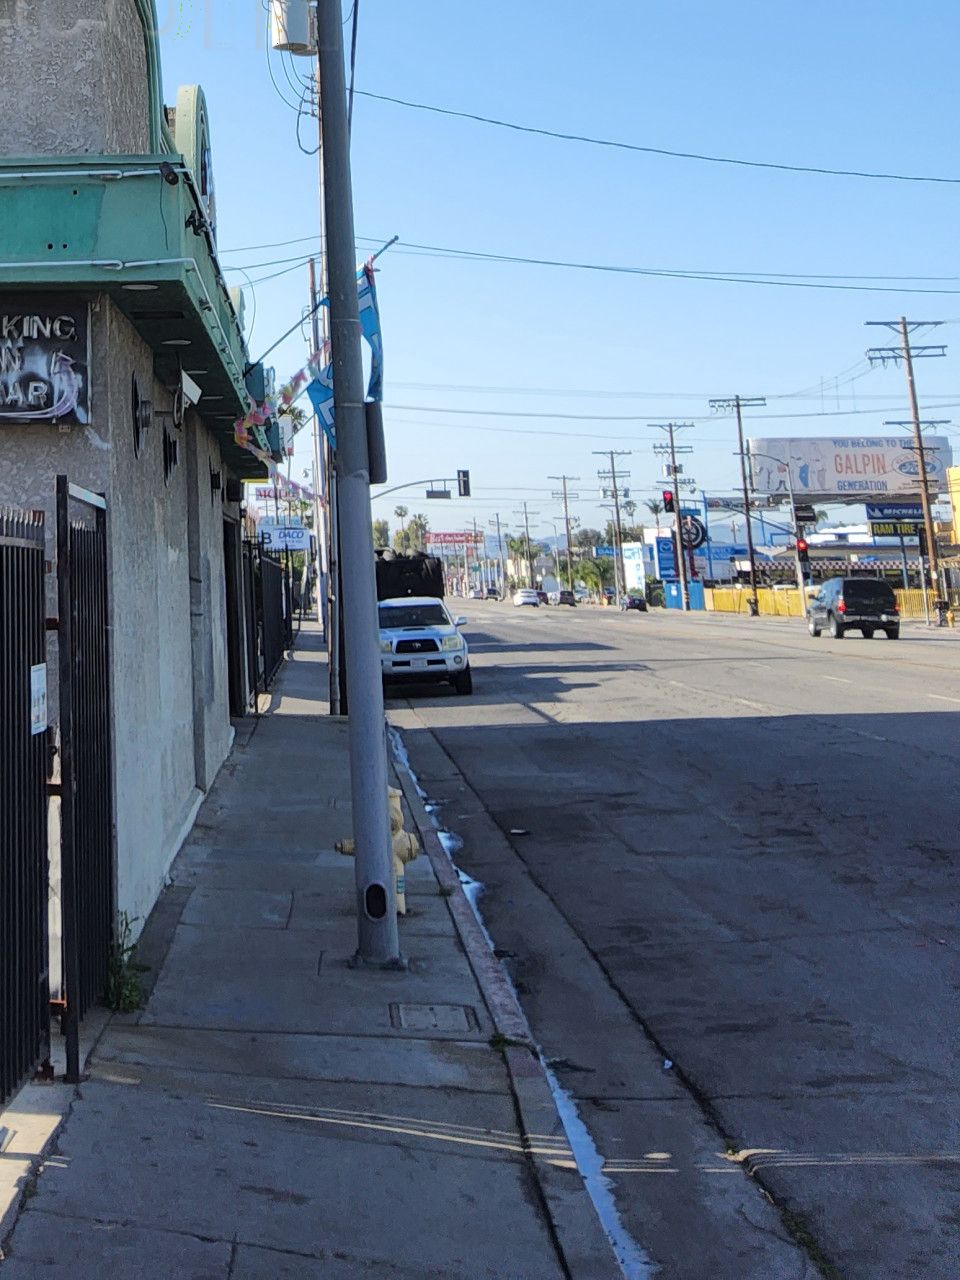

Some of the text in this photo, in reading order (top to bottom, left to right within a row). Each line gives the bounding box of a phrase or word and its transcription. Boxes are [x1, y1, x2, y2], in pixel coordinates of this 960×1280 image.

[886, 439, 897, 448] TO
[834, 453, 888, 475] GALPIN
[837, 480, 888, 491] GENERATION
[883, 508, 924, 516] MICHELI
[873, 523, 894, 534] RAM
[896, 523, 916, 534] TIRE
